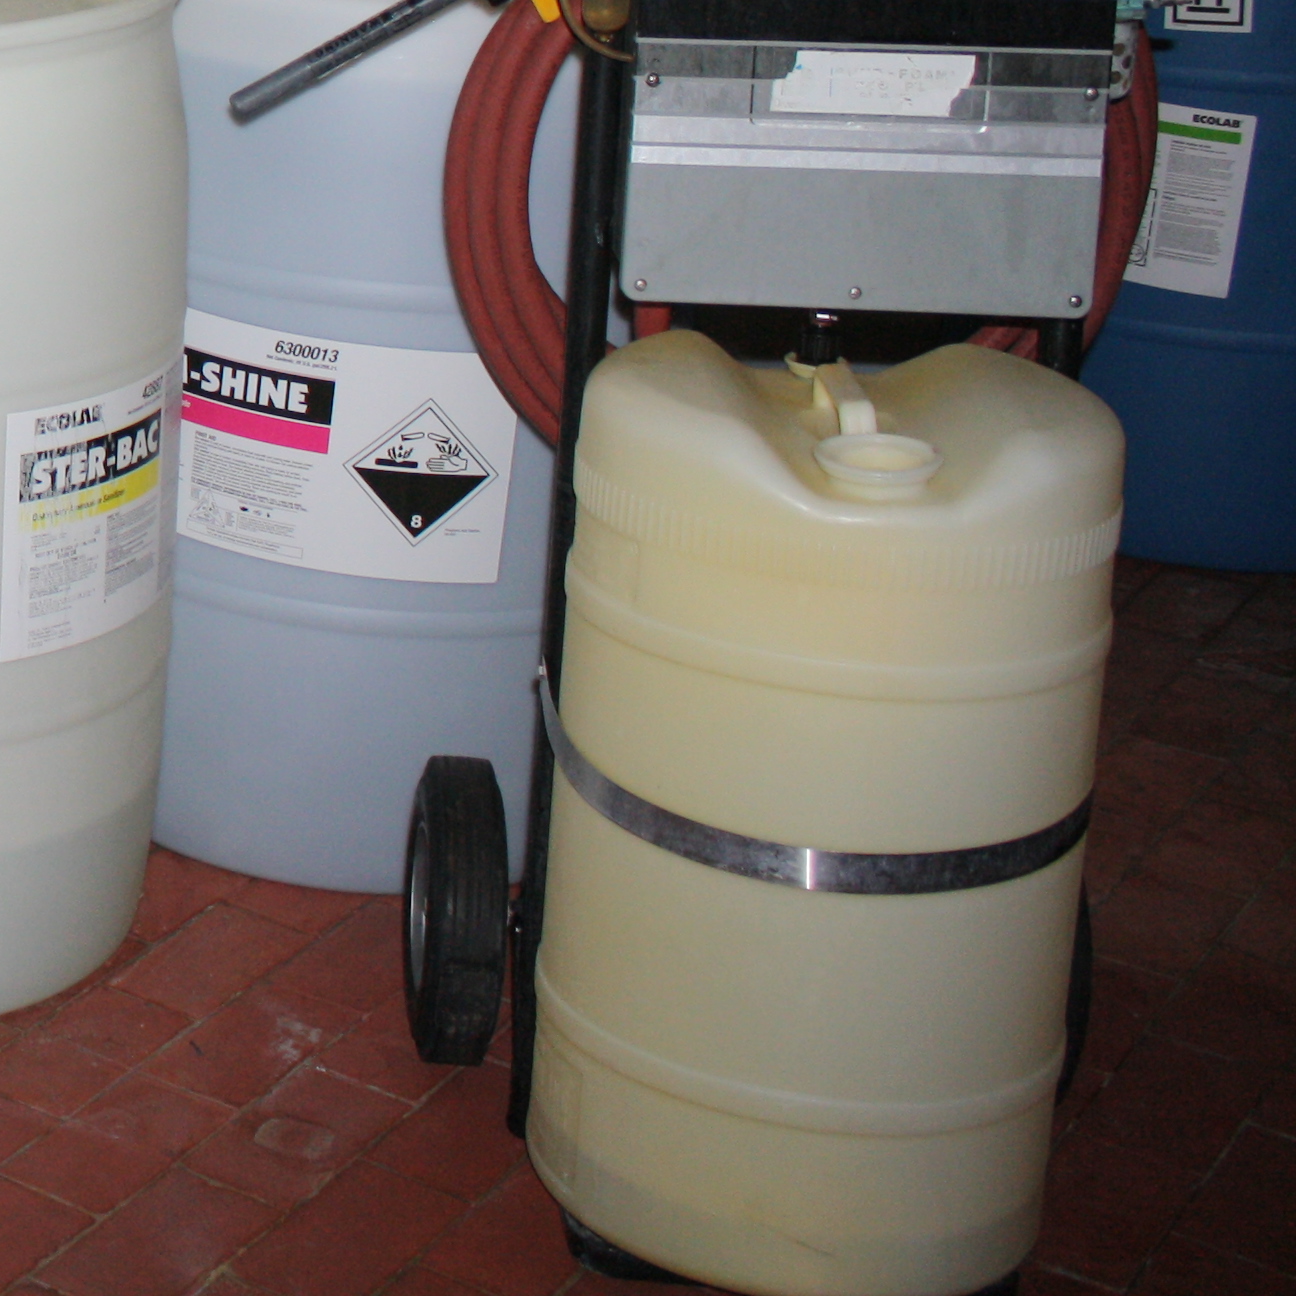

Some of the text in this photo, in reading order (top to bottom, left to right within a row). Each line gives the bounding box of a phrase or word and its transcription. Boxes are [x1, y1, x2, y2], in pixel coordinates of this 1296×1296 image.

[1192, 114, 1240, 129] ECOLAB
[275, 340, 339, 363] 6300013
[31, 419, 160, 494] STER-BAC
[410, 514, 422, 528] 8
